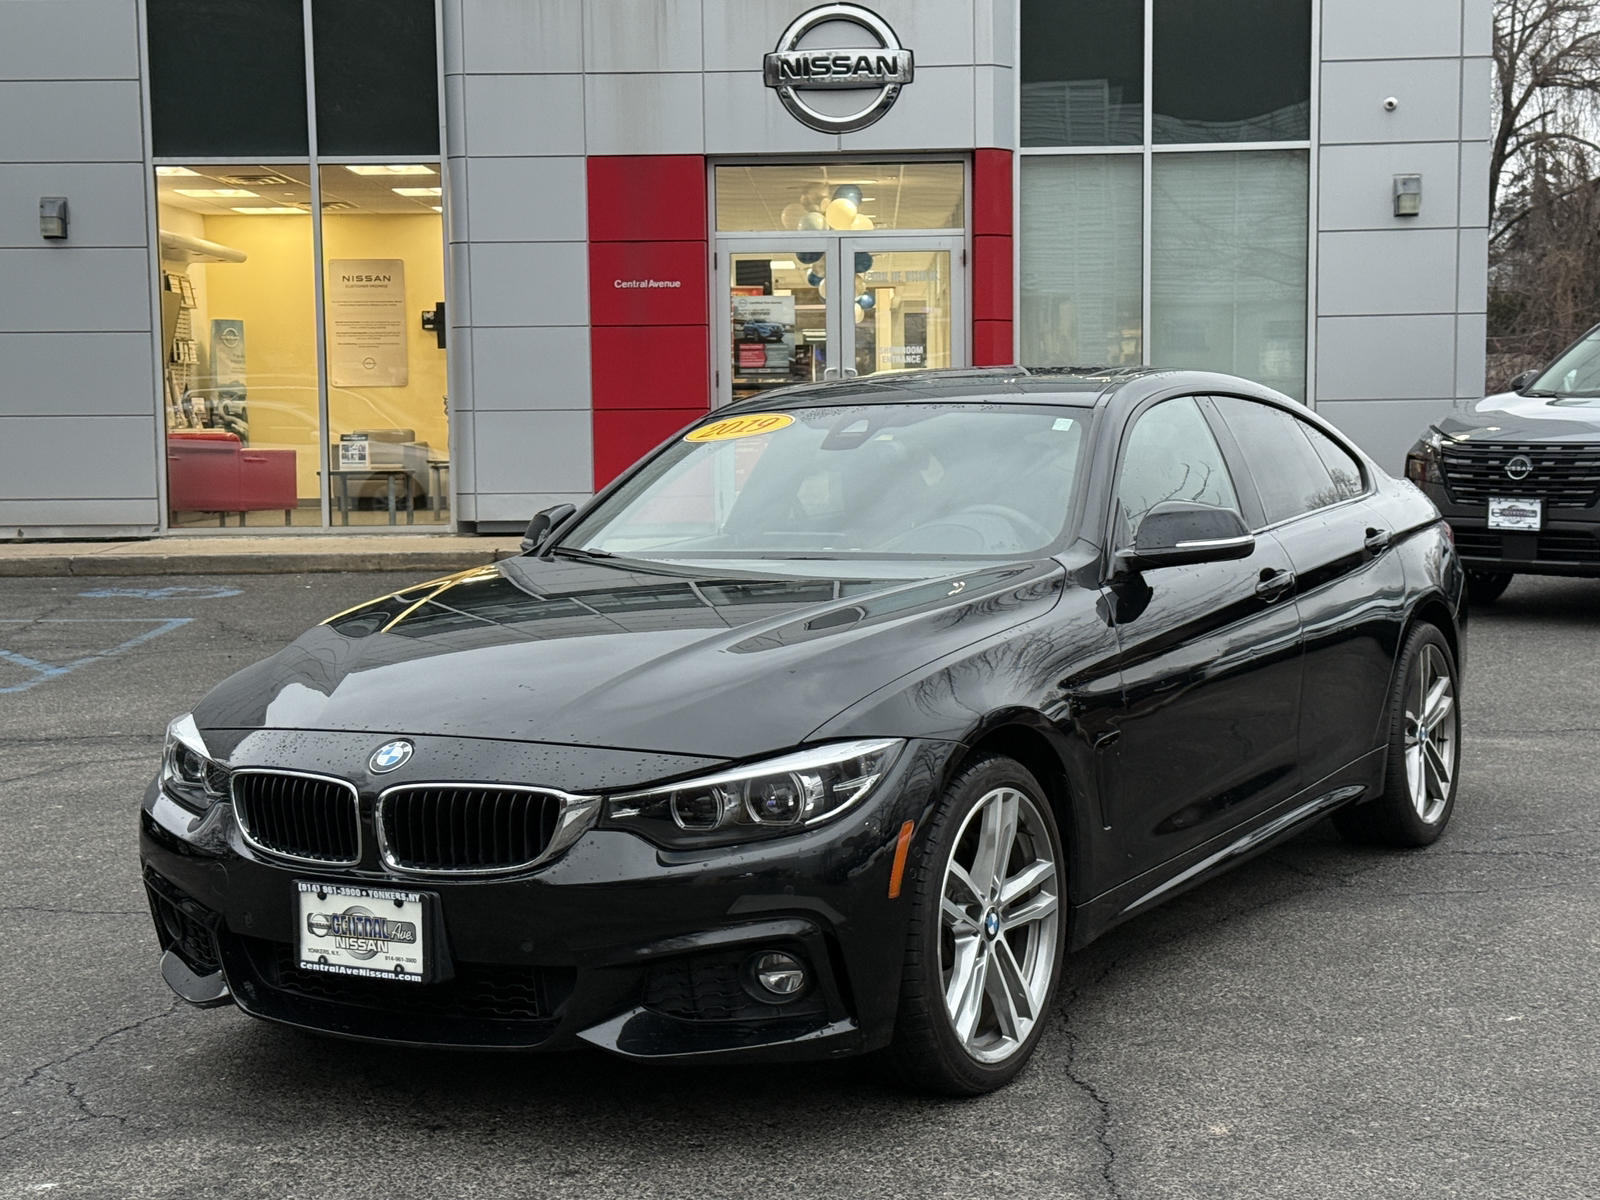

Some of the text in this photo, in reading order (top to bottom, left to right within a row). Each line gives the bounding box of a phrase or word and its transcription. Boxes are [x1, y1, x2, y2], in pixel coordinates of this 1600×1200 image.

[779, 56, 898, 79] NISSAN
[614, 279, 682, 289] Central Avenue
[879, 345, 924, 355] SHOWROOM
[882, 355, 921, 364] ENTRANCE
[696, 417, 780, 439] 2019
[322, 885, 361, 897] 961-3900
[331, 914, 414, 940] CENTRAL Ave.
[335, 936, 389, 953] NISSAN
[300, 961, 422, 983] CentralAveNissan.com
